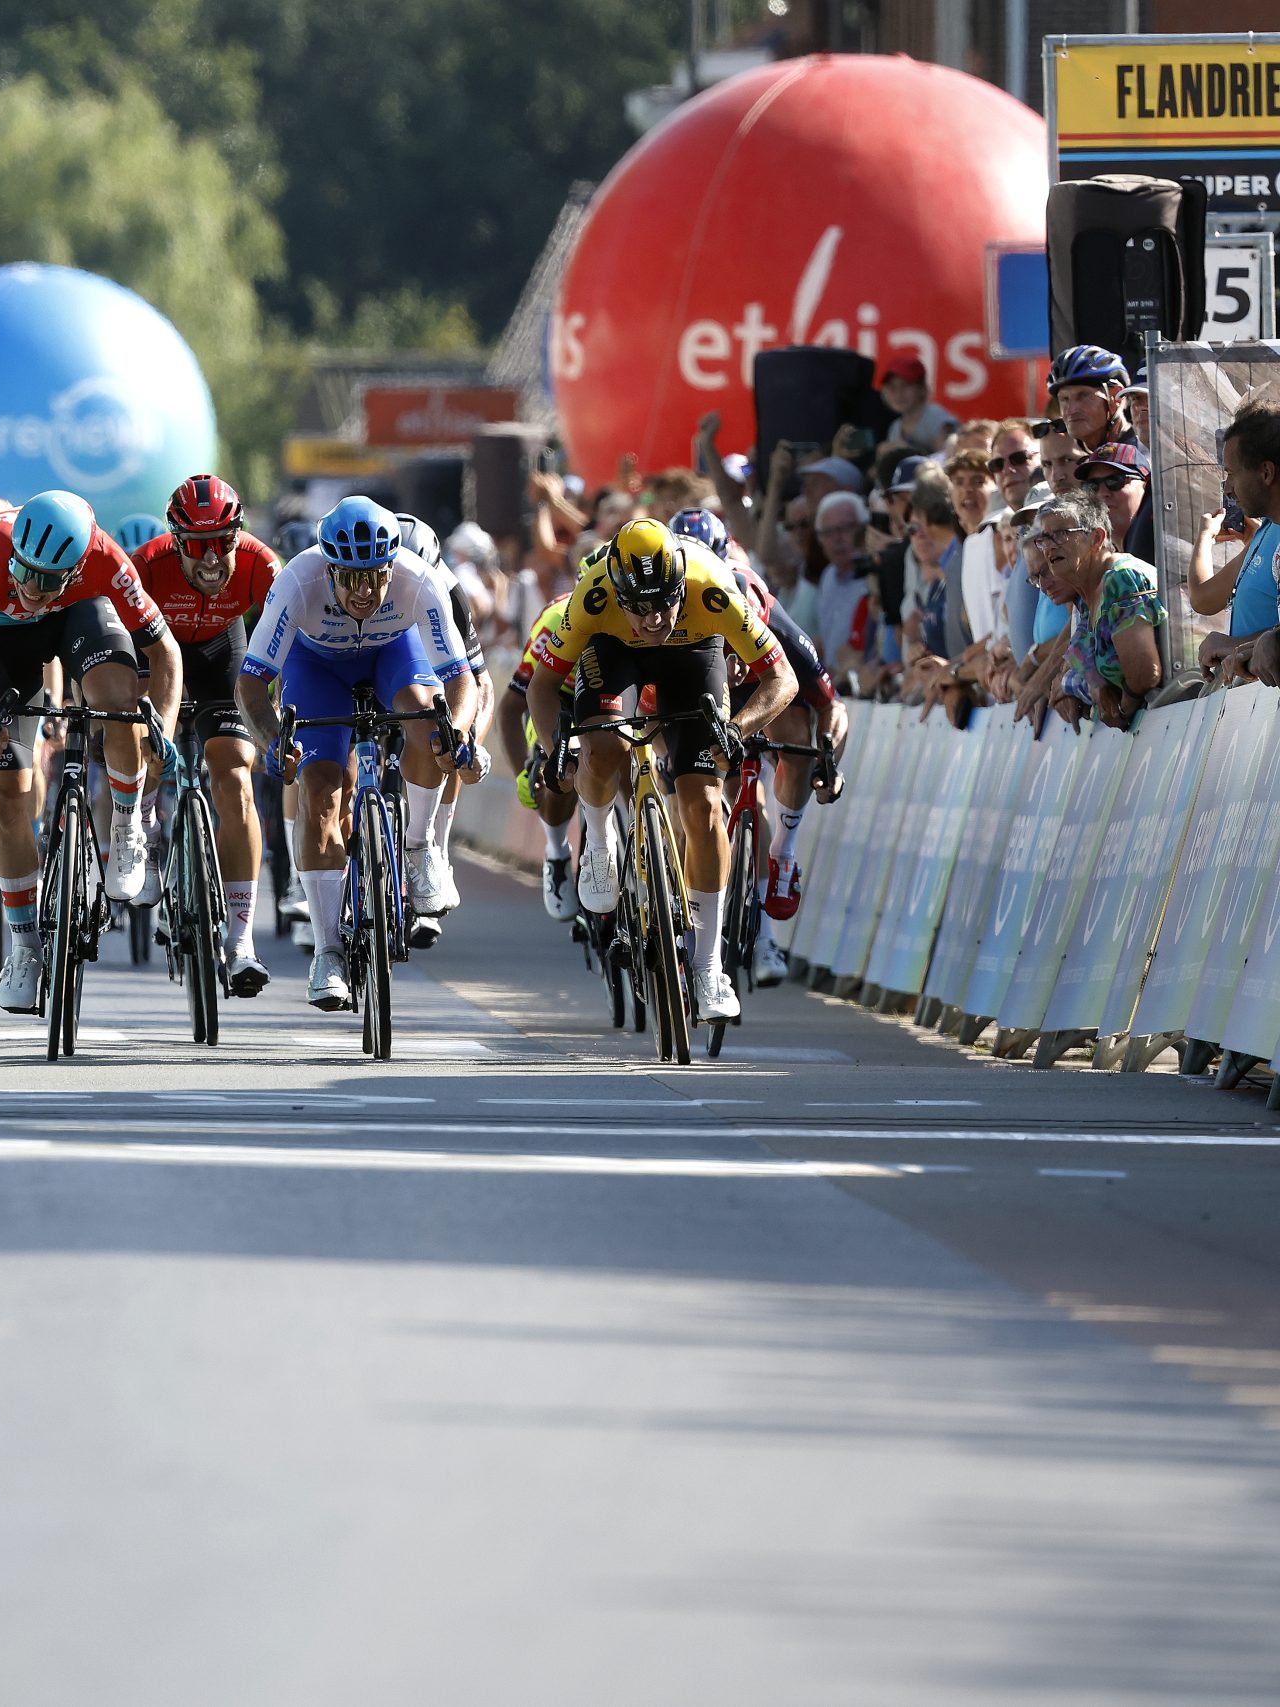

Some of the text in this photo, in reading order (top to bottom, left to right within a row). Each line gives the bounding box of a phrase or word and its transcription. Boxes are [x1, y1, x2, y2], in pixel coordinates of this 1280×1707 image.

[1180, 175, 1272, 196] UPER
[1204, 268, 1251, 323] 5
[641, 556, 654, 576] OLAV
[267, 607, 289, 661] GIANT
[427, 608, 450, 657] GIANT
[83, 657, 107, 672] lotto
[582, 646, 605, 689] JUMBO
[694, 761, 716, 769] AGU
